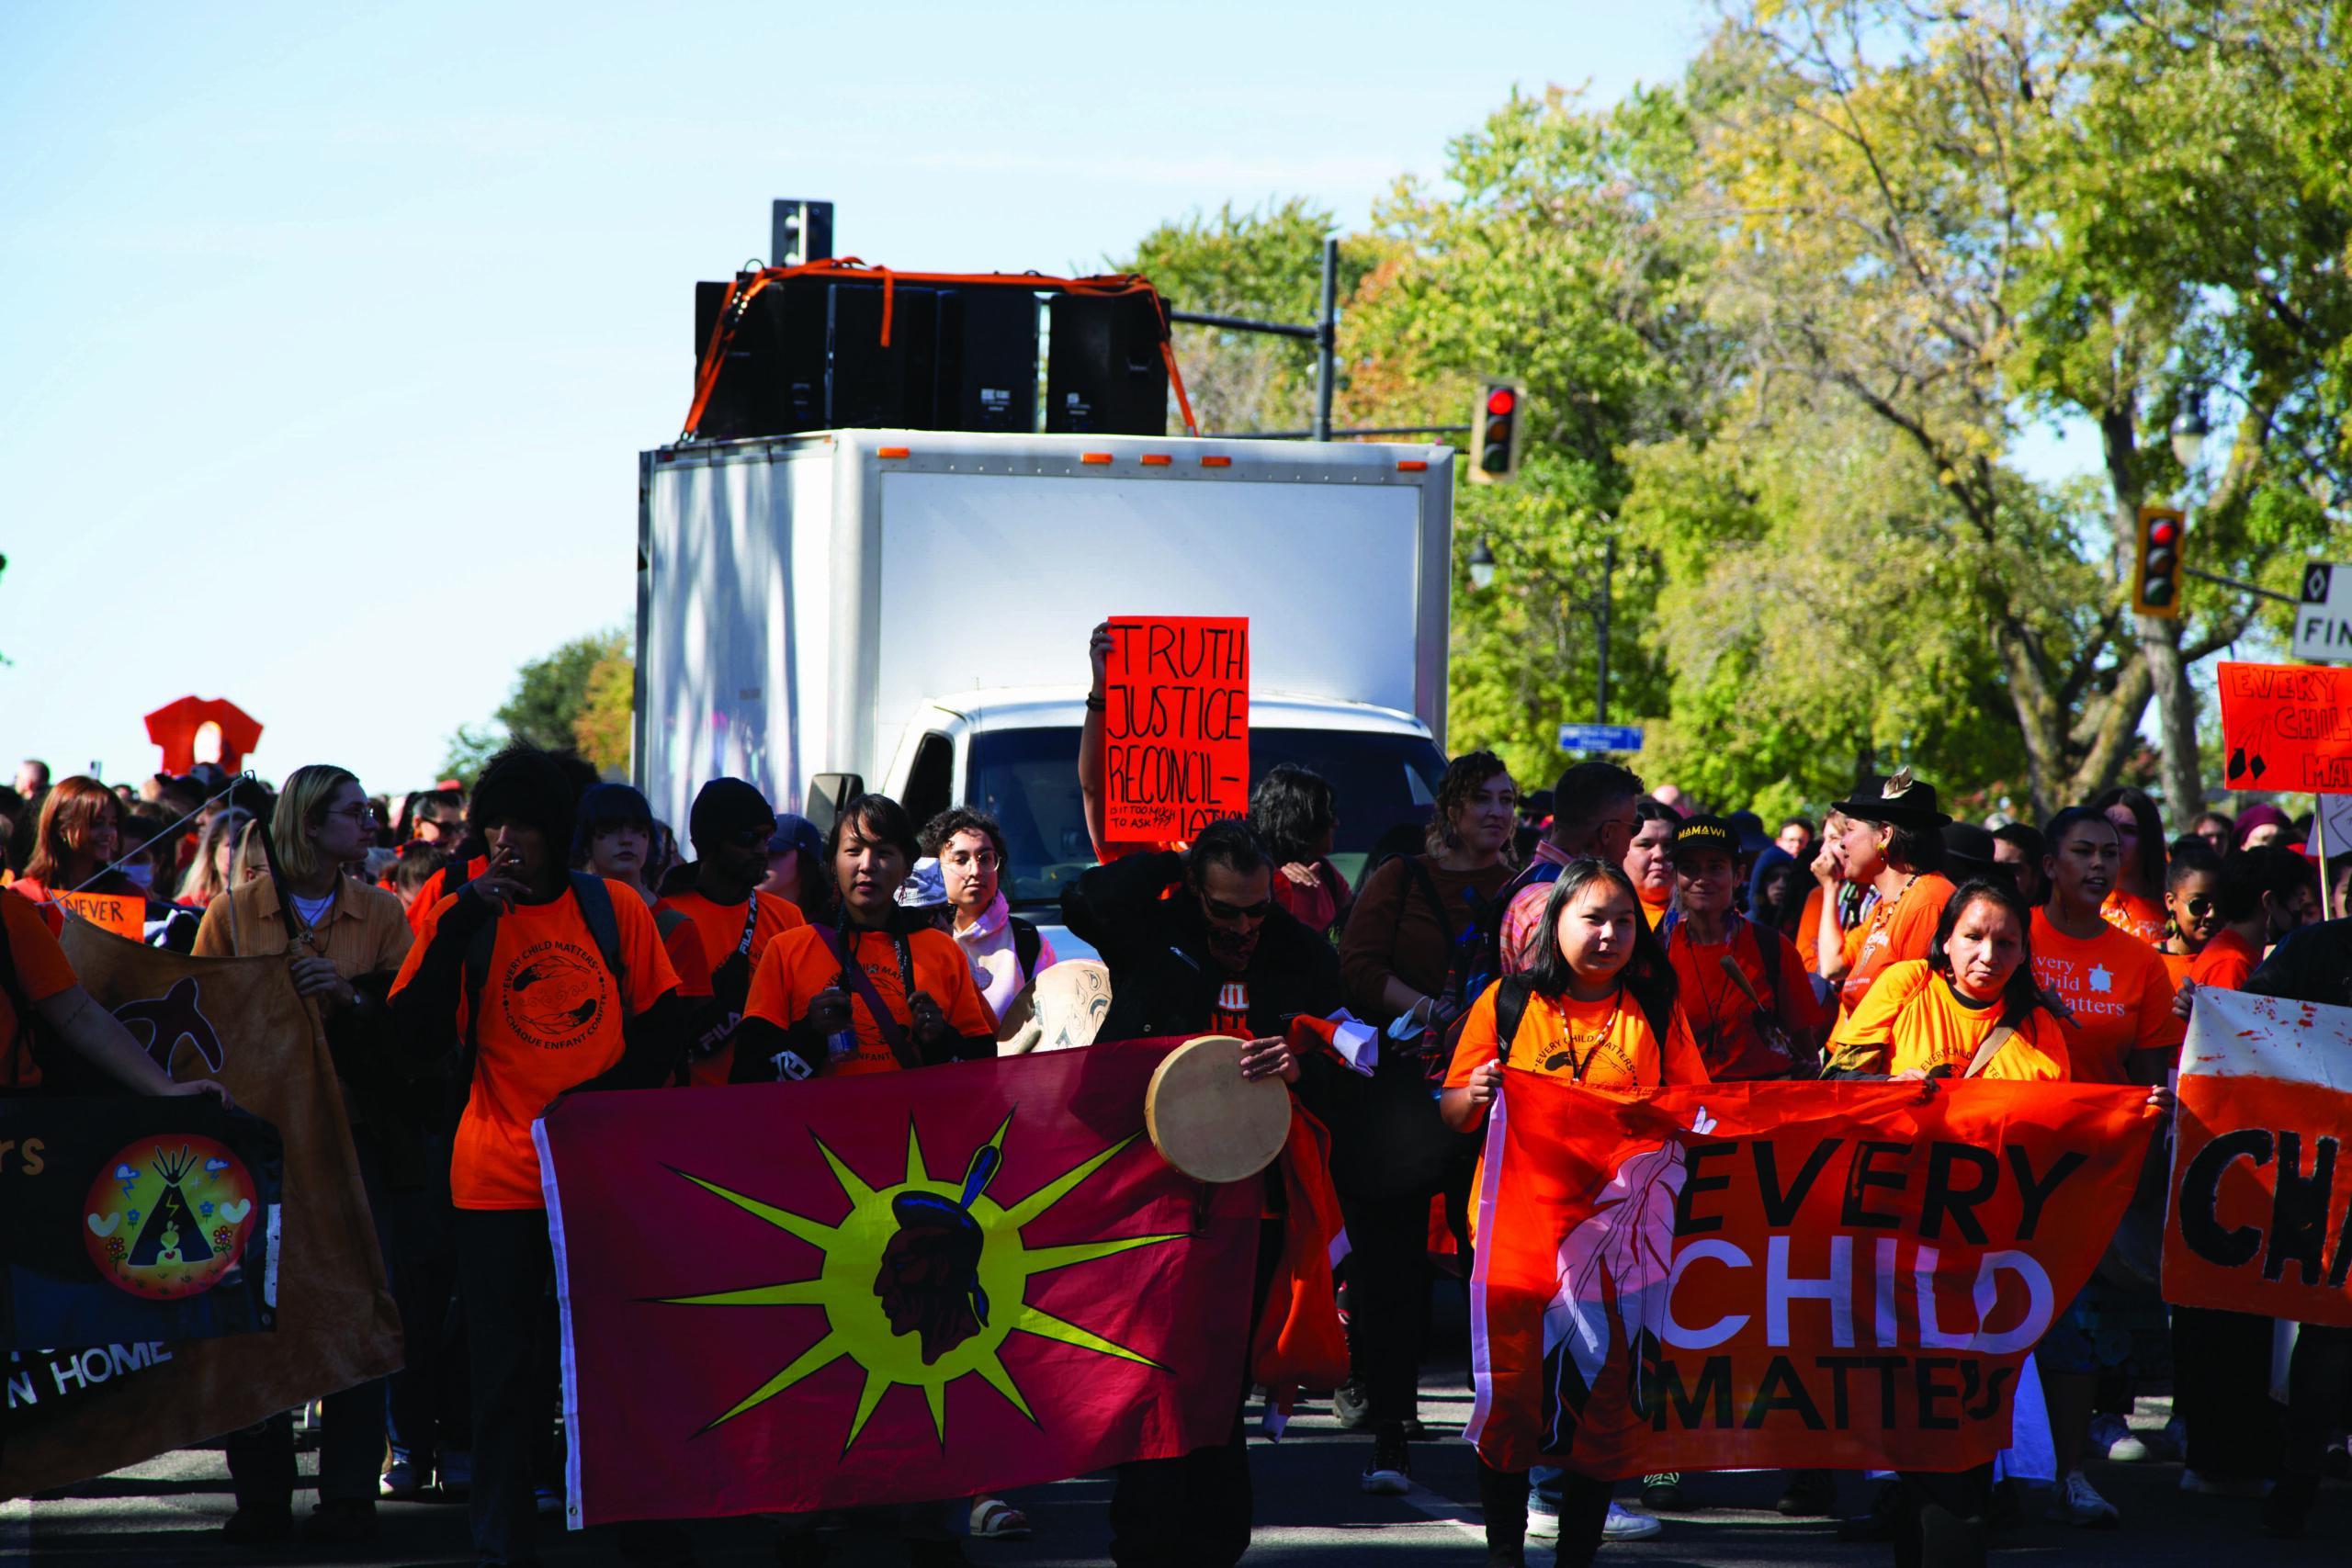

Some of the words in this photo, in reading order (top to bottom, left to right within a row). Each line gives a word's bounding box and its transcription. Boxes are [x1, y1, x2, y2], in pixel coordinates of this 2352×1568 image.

[1111, 625, 1245, 680] TRUTH
[2231, 666, 2339, 702] EVERY
[1107, 685, 1245, 741] JUSTICE
[2274, 705, 2352, 742] CHIL
[1110, 807, 1118, 815] IS
[1119, 807, 1128, 815] IT
[1129, 806, 1148, 815] TOO
[1148, 806, 1176, 820] MUCH
[1110, 818, 1127, 829] TO
[1678, 825, 1726, 841] MAMAWI
[64, 899, 124, 921] NEVER
[738, 929, 753, 955] FILA
[503, 956, 522, 989] EVERY
[522, 941, 552, 960] CHILD
[555, 941, 598, 969] MATTERS
[506, 1015, 542, 1047] CHAQUE
[544, 1034, 586, 1050] ENFANT
[587, 993, 607, 1035] COMPTE
[2057, 992, 2125, 1017] atters
[699, 1011, 741, 1051] FILA
[857, 1052, 890, 1062] NFANT
[1535, 1039, 1562, 1065] EVERY
[1564, 1034, 1594, 1044] CHILD
[1597, 1039, 1635, 1072] MATTERS
[1920, 1049, 1947, 1072] EVERY
[1674, 1137, 2089, 1246] EVERY
[1660, 1234, 2055, 1355] CHILD
[50, 1341, 173, 1395] HOME
